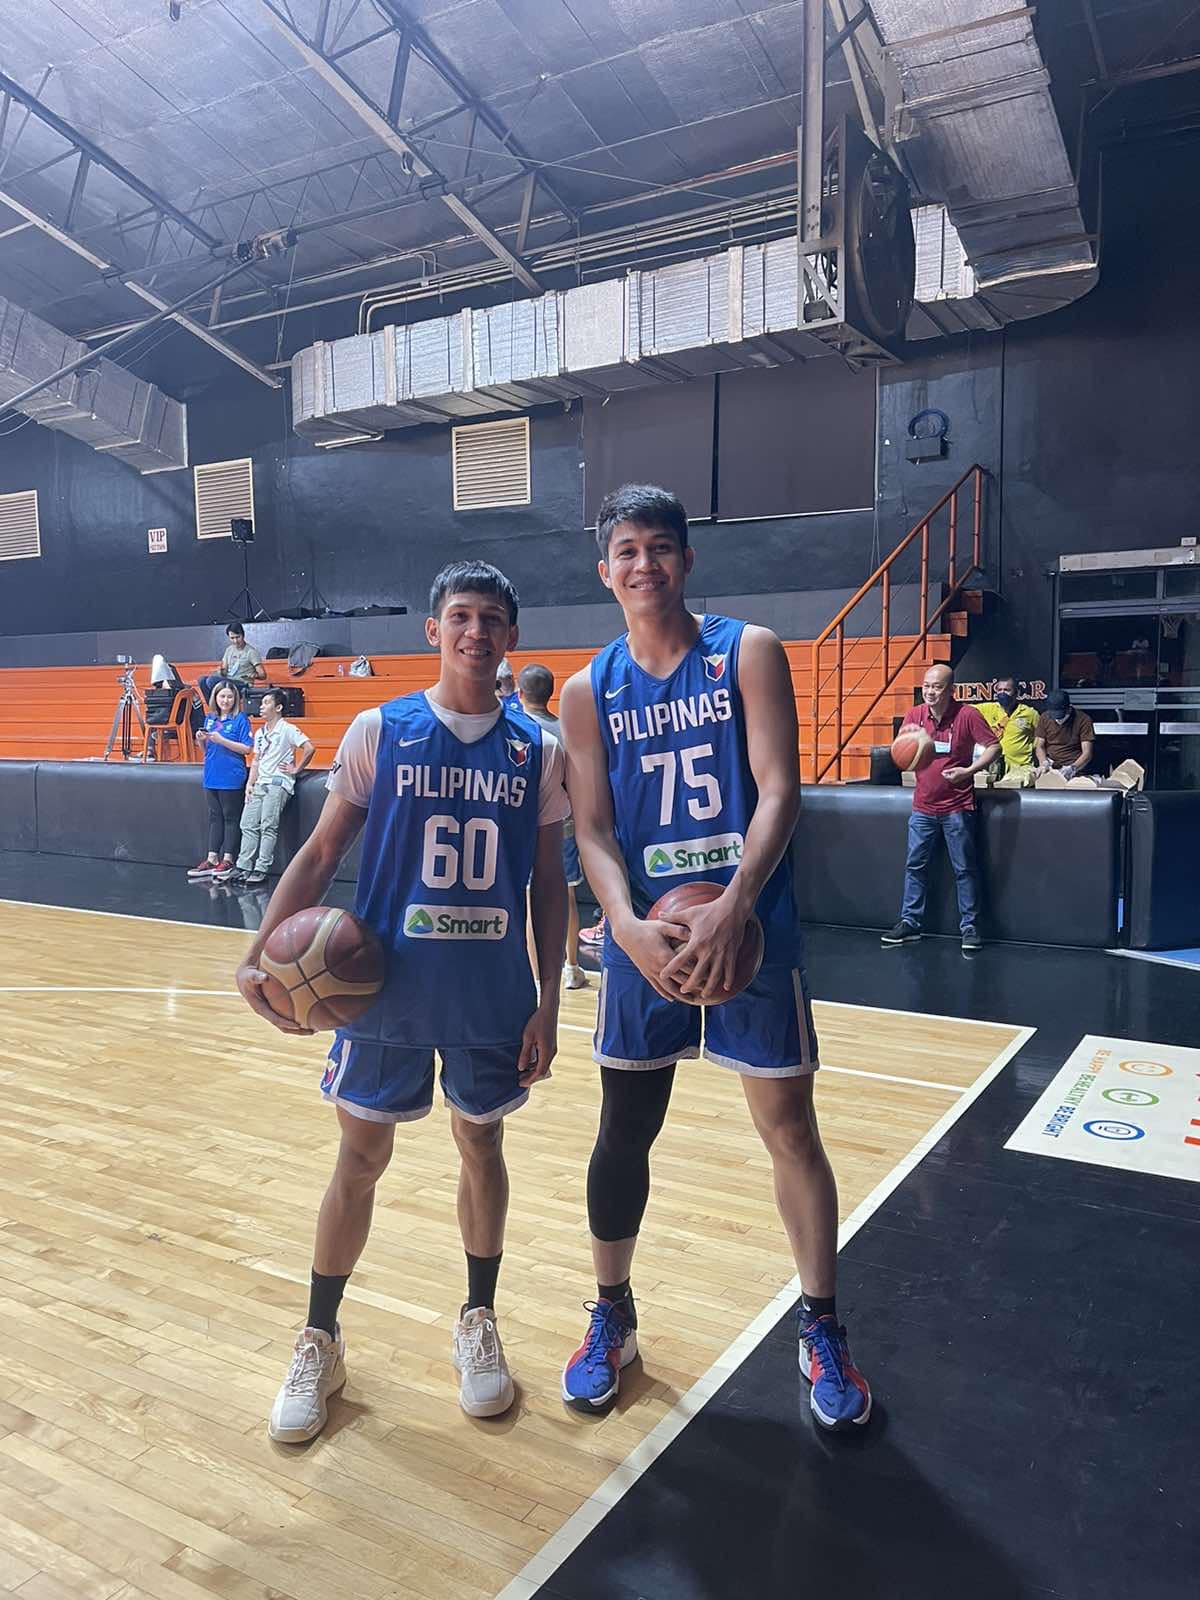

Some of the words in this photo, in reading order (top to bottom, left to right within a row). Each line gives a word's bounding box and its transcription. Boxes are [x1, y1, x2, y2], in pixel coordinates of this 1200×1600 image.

[149, 530, 165, 542] VIP
[608, 688, 732, 745] PILIPINAS
[396, 764, 527, 808] PILIPINAS
[640, 743, 723, 826] 75
[421, 814, 499, 890] 60
[675, 841, 742, 869] Smart
[436, 913, 503, 934] Smart
